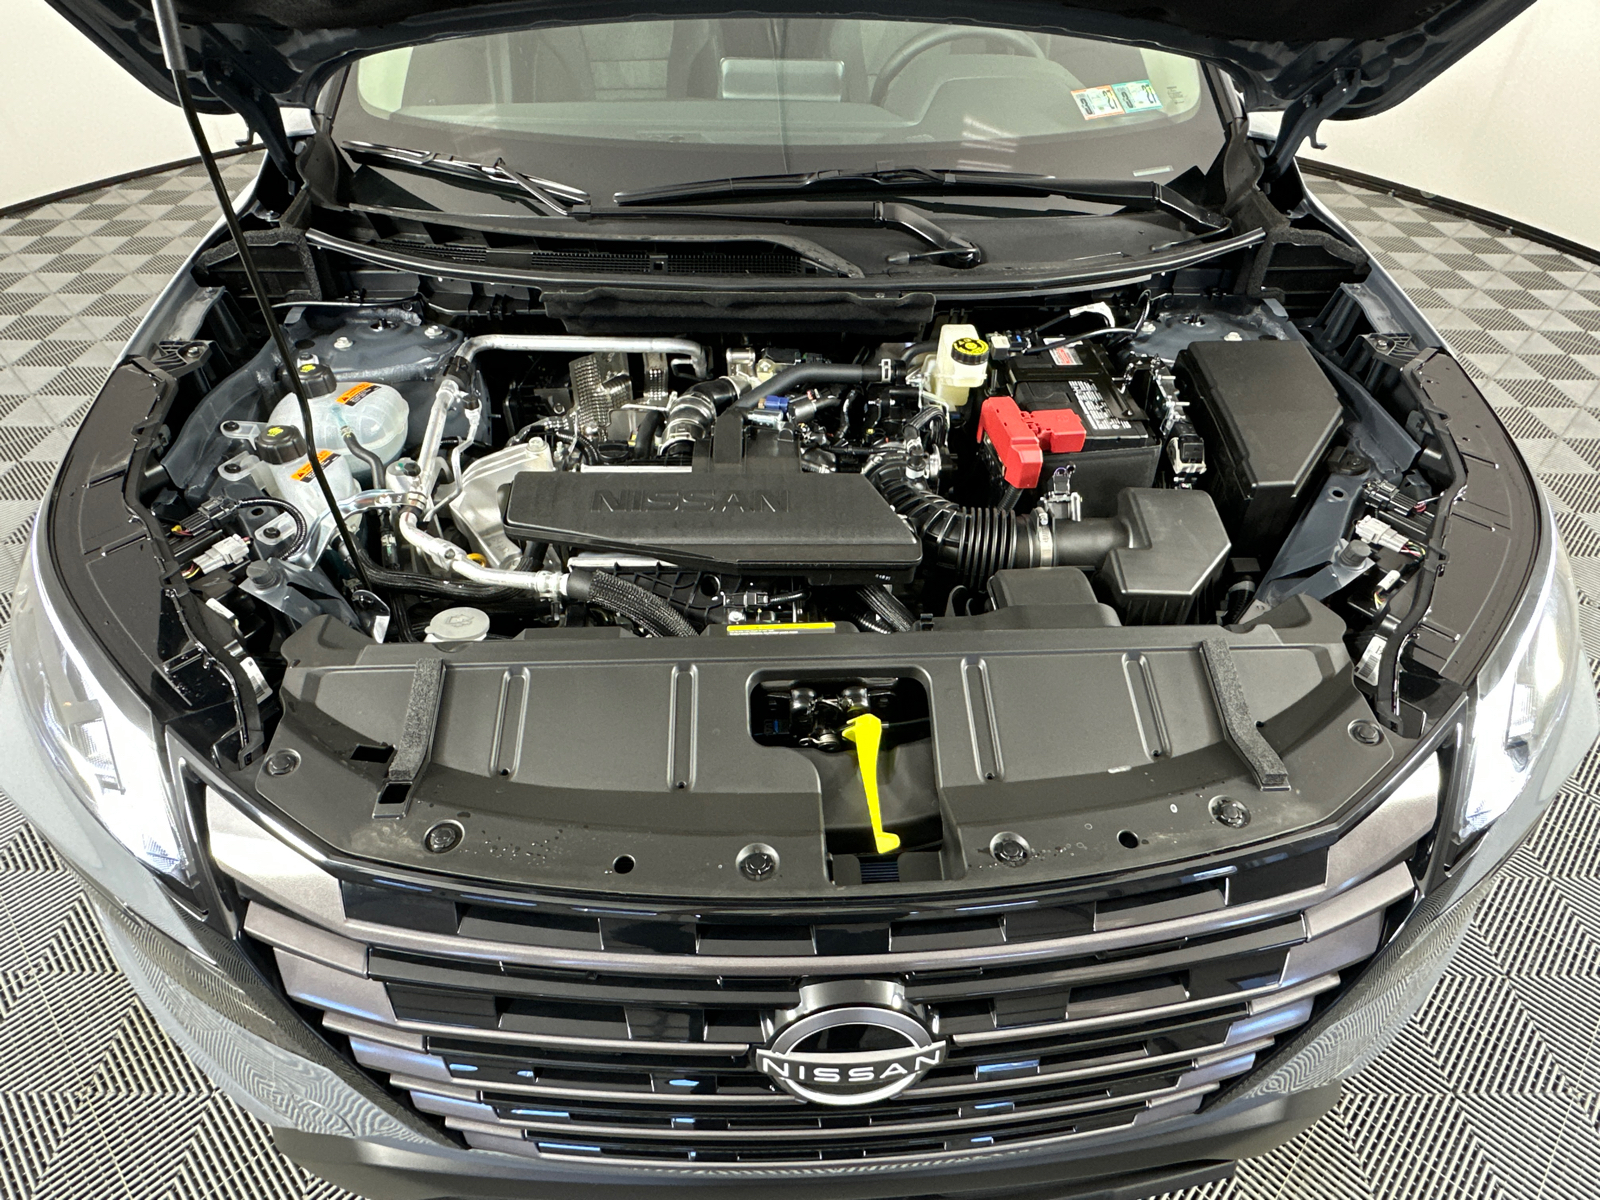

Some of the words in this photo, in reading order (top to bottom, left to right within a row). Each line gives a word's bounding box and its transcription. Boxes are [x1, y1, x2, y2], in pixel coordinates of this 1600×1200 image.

[1102, 90, 1118, 110] 27
[1121, 91, 1134, 109] 3
[1141, 84, 1157, 104] 27
[1080, 98, 1093, 115] 3
[590, 489, 789, 513] NISSAN
[762, 1049, 941, 1083] NISSAN
